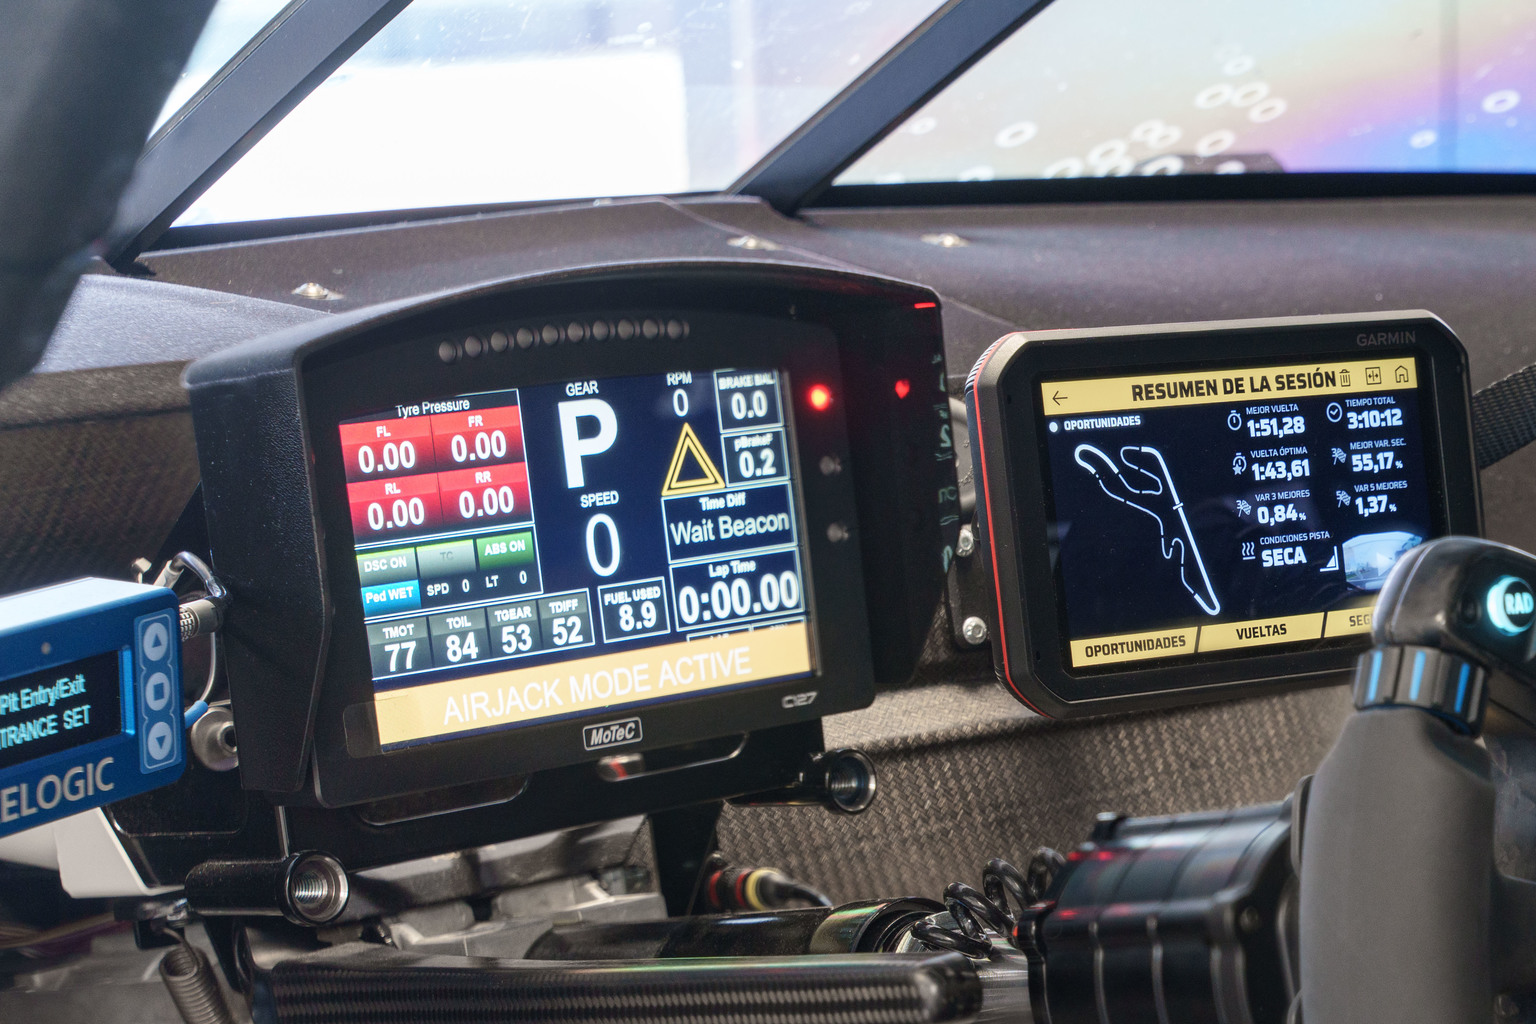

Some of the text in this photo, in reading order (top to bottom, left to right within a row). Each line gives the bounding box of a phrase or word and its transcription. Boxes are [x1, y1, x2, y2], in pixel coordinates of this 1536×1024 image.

[1356, 331, 1416, 347] GARMIN
[666, 371, 692, 386] RPM
[718, 374, 754, 390] BRAKE
[1131, 367, 1337, 402] RESUMEN DE LA SESIÓN
[566, 380, 599, 397] GEAR
[395, 399, 470, 419] Tyre Pressure
[672, 388, 689, 417] 0
[731, 390, 768, 420] 0.0
[1246, 403, 1299, 415] MEJOR VUELTA
[1345, 396, 1396, 407] TIEMPO TOTAL
[468, 415, 483, 427] FR
[1063, 415, 1141, 431] OPORTUNIDADES
[1247, 415, 1306, 438] 1:51,28
[1347, 408, 1403, 430] 3:10:12
[376, 426, 391, 437] FL
[451, 430, 507, 463] 0.00
[557, 398, 618, 489] P
[1250, 446, 1308, 459] VUELTA ÓPTIMA
[1350, 438, 1407, 450] MEJOR VAR. SEC.
[358, 440, 416, 474] 0.00
[738, 448, 777, 478] 0.2
[1351, 451, 1403, 474] 55,17 %
[475, 471, 492, 484] RR
[1251, 458, 1310, 481] 1:43,61
[384, 483, 401, 495] RL
[1255, 489, 1311, 502] VAR 3 MEJORES
[1354, 480, 1408, 493] VAR 5 MEJORES
[459, 486, 514, 519] 0.00
[580, 490, 619, 508] SPEED
[699, 492, 746, 511] Time Diff
[1355, 495, 1397, 517] 1,37 %
[368, 497, 425, 531] 0.00
[1257, 503, 1307, 526] 0,84 %
[670, 512, 790, 546] Wait Beacon
[1260, 530, 1330, 545] CONDICIONES PISTA
[484, 539, 526, 556] ABS ON
[585, 513, 621, 577] 0
[364, 556, 407, 572] DSC ON
[440, 551, 454, 562] TC
[1261, 546, 1307, 568] SECA
[485, 570, 528, 588] LT 0
[708, 560, 756, 579] Lap Time
[365, 586, 414, 603] Ped WET
[427, 579, 470, 596] SPD 0
[604, 586, 661, 605] FUEL USED
[678, 570, 800, 624] 0:00.00
[549, 598, 578, 614] TDIFF
[1505, 592, 1534, 615] RAD
[446, 615, 472, 630] TOIL
[494, 606, 532, 622] TGEAR
[618, 600, 657, 632] 8.9
[383, 624, 414, 639] TMOT
[501, 623, 533, 654] 53
[552, 615, 583, 646] 52
[1236, 623, 1287, 641] VUELTAS
[446, 631, 479, 663] 84
[1084, 634, 1186, 658] OPORTUNIDADES
[384, 641, 416, 673] 77
[20, 674, 86, 707] Entry/Exit
[443, 647, 752, 726] AIRJACK MODE ACTIVE
[0, 705, 91, 749] TRANCE SET
[590, 720, 636, 747] MoTeC
